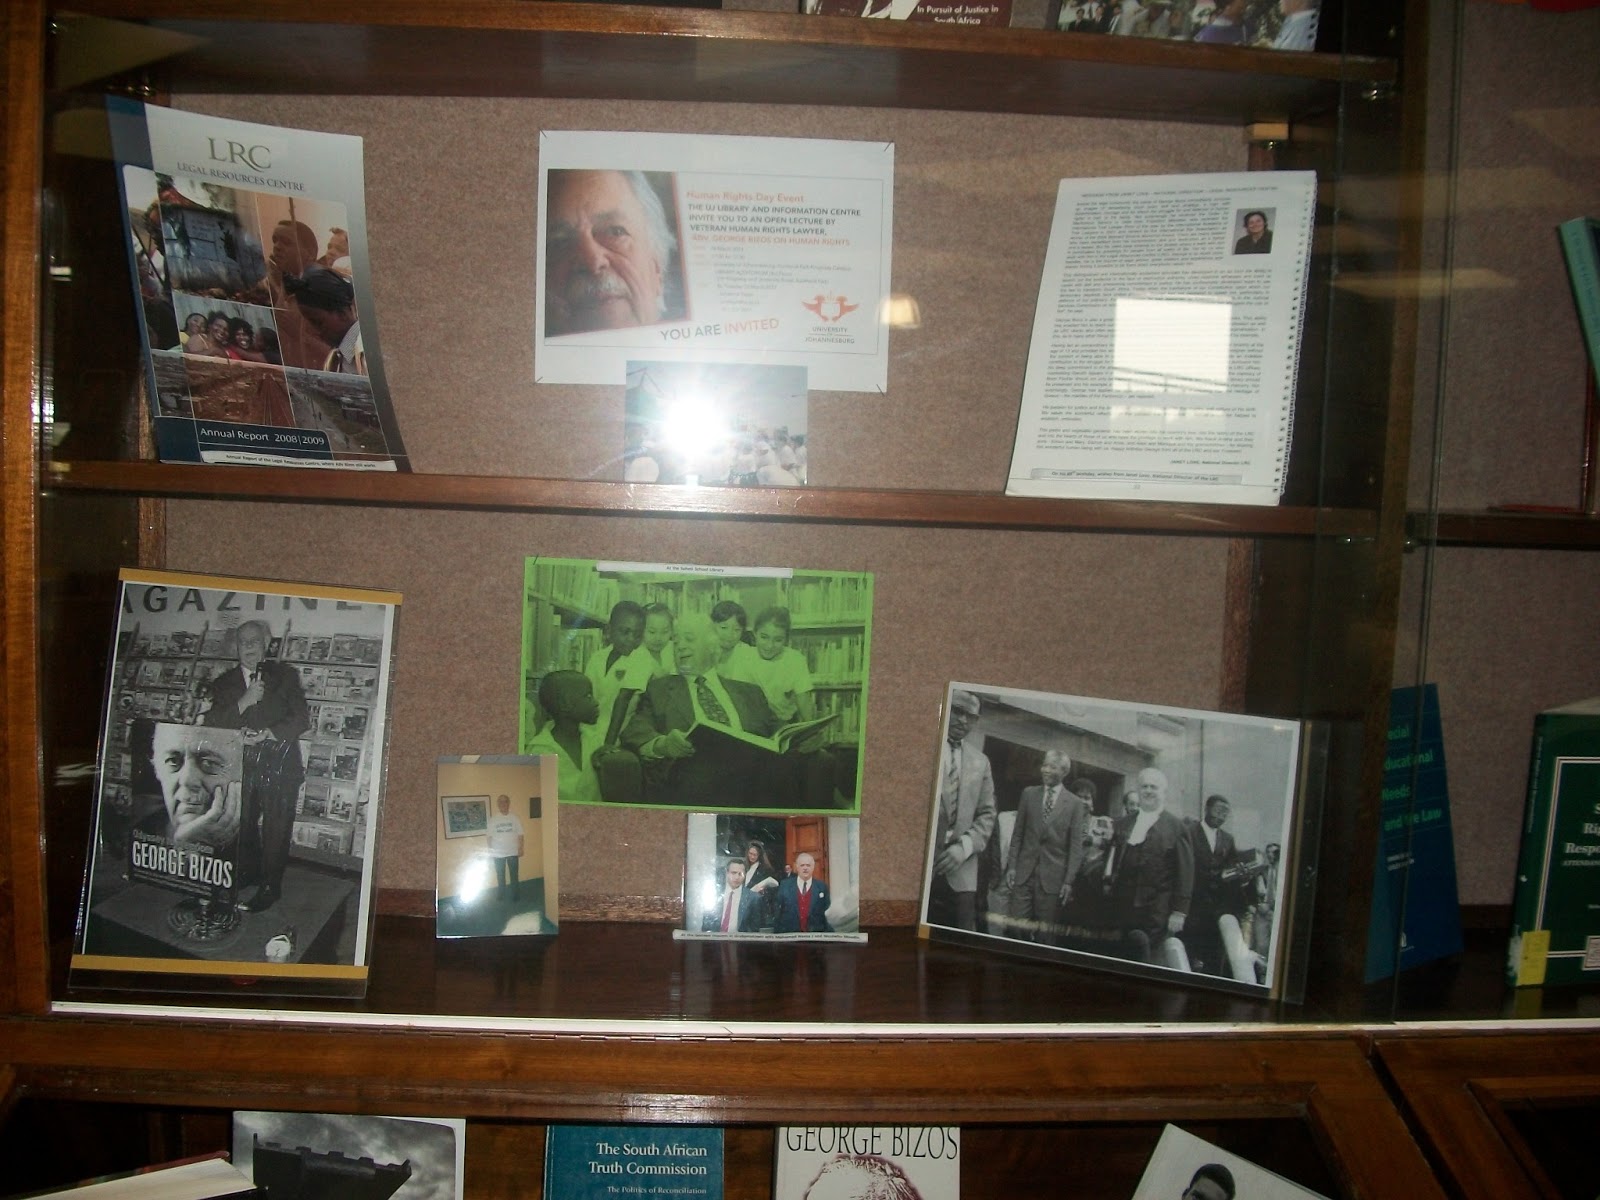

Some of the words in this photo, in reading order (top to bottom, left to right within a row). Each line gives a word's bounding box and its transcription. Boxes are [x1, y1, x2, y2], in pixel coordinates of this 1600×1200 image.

[917, 5, 924, 13] In
[927, 5, 952, 14] Pursuit
[954, 5, 963, 13] of
[965, 5, 989, 14] Justice
[991, 5, 999, 13] in
[934, 16, 955, 24] South
[957, 16, 981, 24] Africa
[208, 137, 272, 172] LRC
[177, 162, 208, 176] LEGAL
[210, 169, 265, 186] RESOURCES
[266, 179, 305, 192] CENTRE
[687, 192, 720, 201] Human
[723, 192, 752, 203] Rights
[756, 192, 774, 204] Day
[778, 193, 804, 203] Event
[705, 204, 716, 212] UJ
[717, 204, 750, 212] LIBRARY
[752, 206, 770, 214] AND
[772, 206, 828, 216] INFORMATION
[830, 208, 861, 216] CENTRE
[689, 214, 715, 222] INVITE
[718, 214, 735, 222] YOU
[764, 216, 787, 224] OPEN
[789, 217, 823, 225] LECTURE
[826, 218, 836, 226] BY
[690, 224, 727, 232] VETERAN
[729, 225, 760, 233] HUMAN
[762, 226, 791, 234] RIGHTS
[792, 227, 827, 236] LAWYER,
[712, 235, 746, 243] GEORGE
[789, 238, 820, 246] HUMAN
[822, 238, 851, 247] RIGHTS
[660, 327, 691, 341] YOU
[694, 324, 721, 338] ARE
[724, 318, 780, 336] INVITED
[812, 326, 848, 334] UNIVERSITY
[804, 336, 855, 344] JOHANNESBURG
[200, 428, 235, 438] Annual
[238, 430, 270, 442] Report
[1384, 815, 1403, 831] and
[1421, 808, 1442, 822] Law
[132, 840, 185, 877] GEORGE
[189, 853, 234, 889] BIZOS
[596, 1142, 620, 1156] The
[622, 1143, 660, 1156] South
[662, 1144, 708, 1156] African
[786, 1126, 882, 1155] GEORGE
[892, 1126, 958, 1160] BIZOS
[588, 1161, 623, 1174] Truth
[626, 1162, 707, 1175] Commission
[607, 1186, 620, 1194] The
[622, 1186, 647, 1194] Politics
[648, 1186, 656, 1194] of
